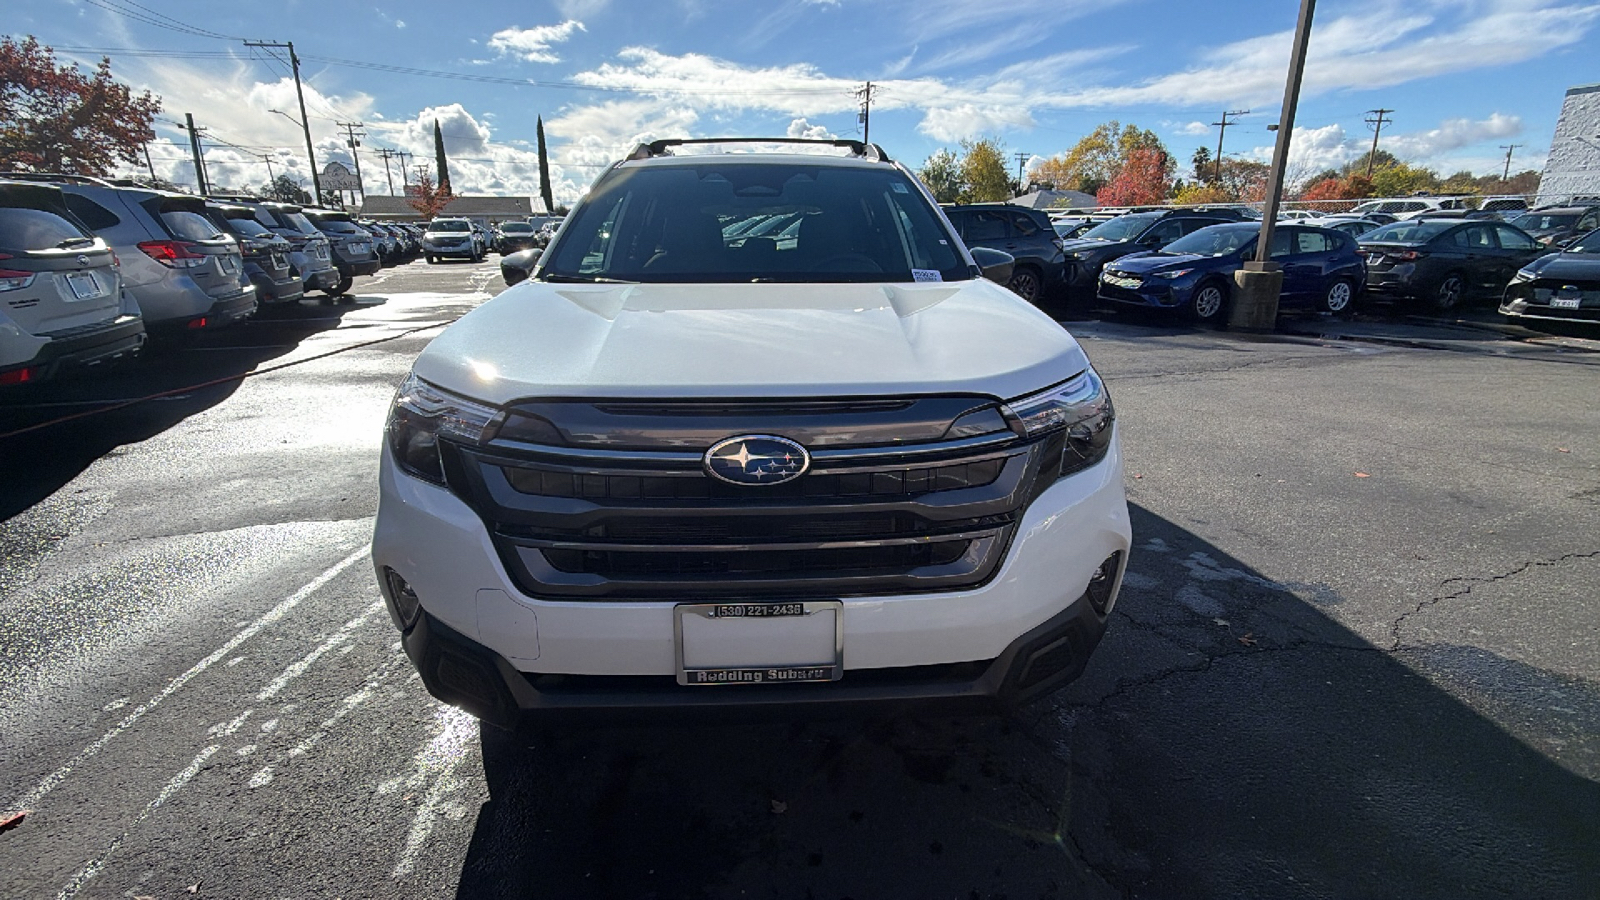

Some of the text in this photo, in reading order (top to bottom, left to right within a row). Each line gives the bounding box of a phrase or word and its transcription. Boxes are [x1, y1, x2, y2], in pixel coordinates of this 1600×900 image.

[717, 606, 746, 616] (530)
[697, 669, 824, 683] Redding Subaru
